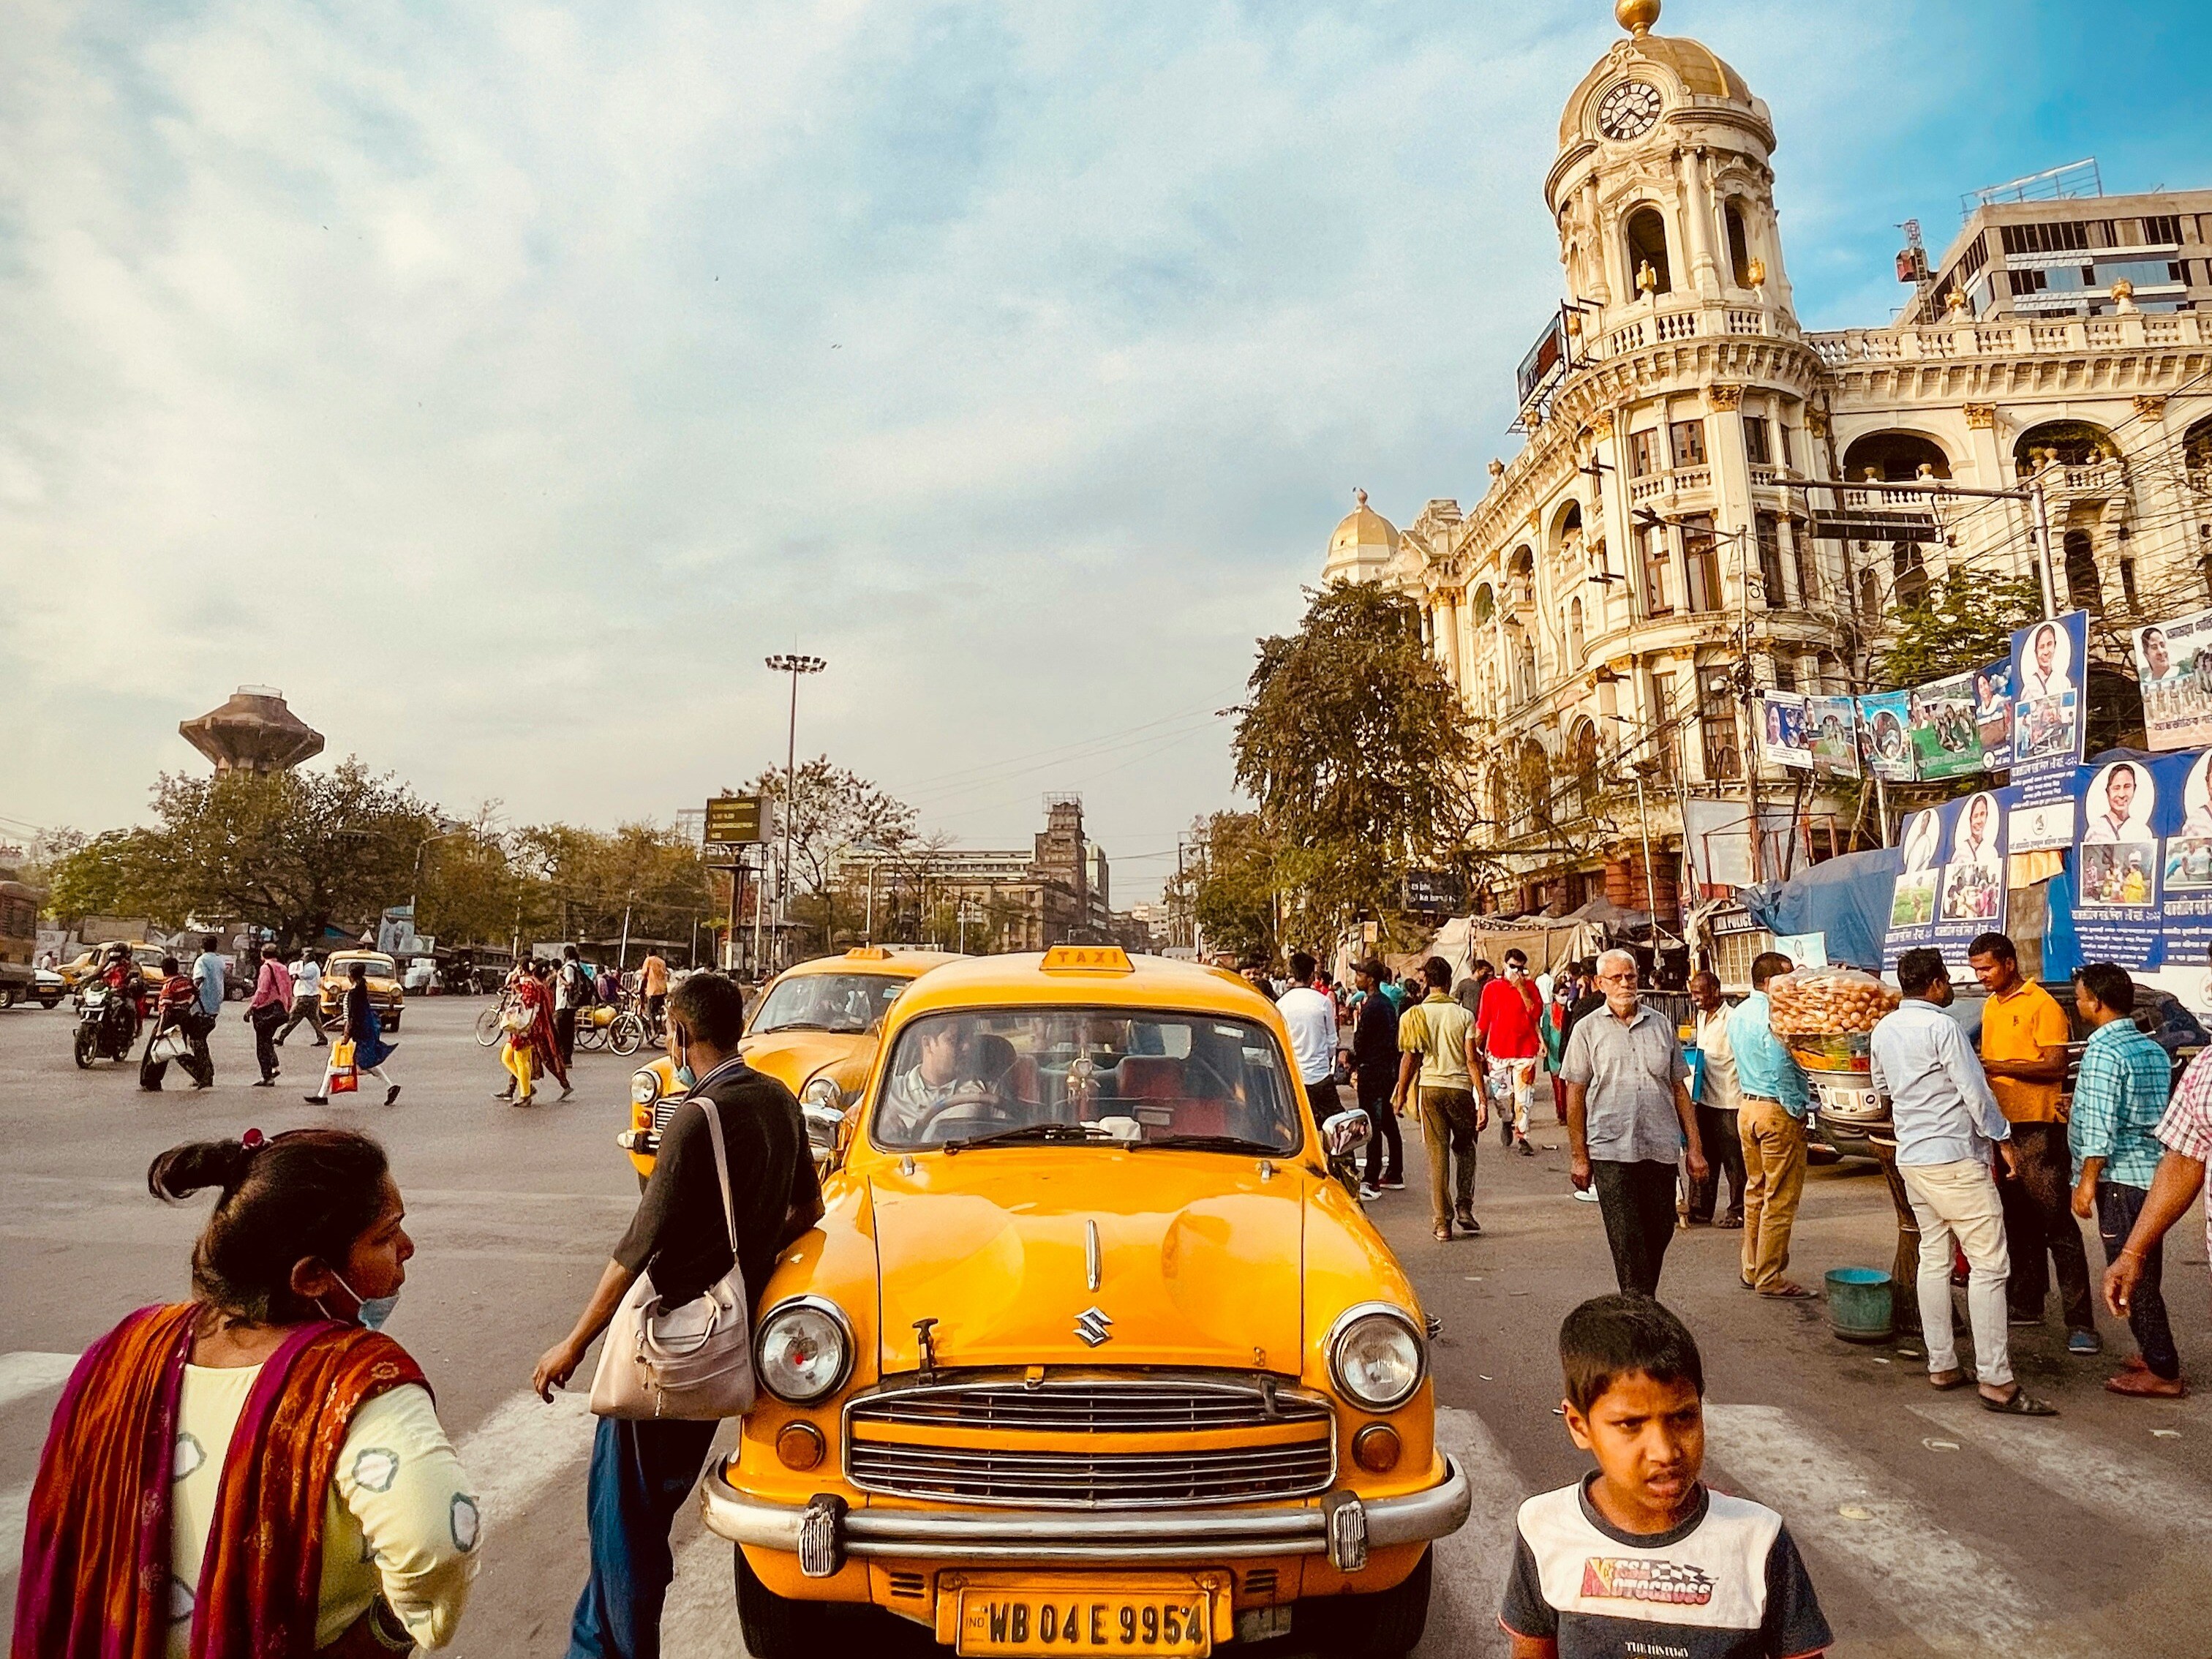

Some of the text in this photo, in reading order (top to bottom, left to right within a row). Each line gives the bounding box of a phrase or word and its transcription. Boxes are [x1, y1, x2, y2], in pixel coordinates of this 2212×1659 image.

[1726, 912, 1753, 928] POLICE
[1057, 951, 1118, 963] TAXI
[966, 1617, 985, 1628] IND
[989, 1603, 1203, 1646] WB 04 E 9954
